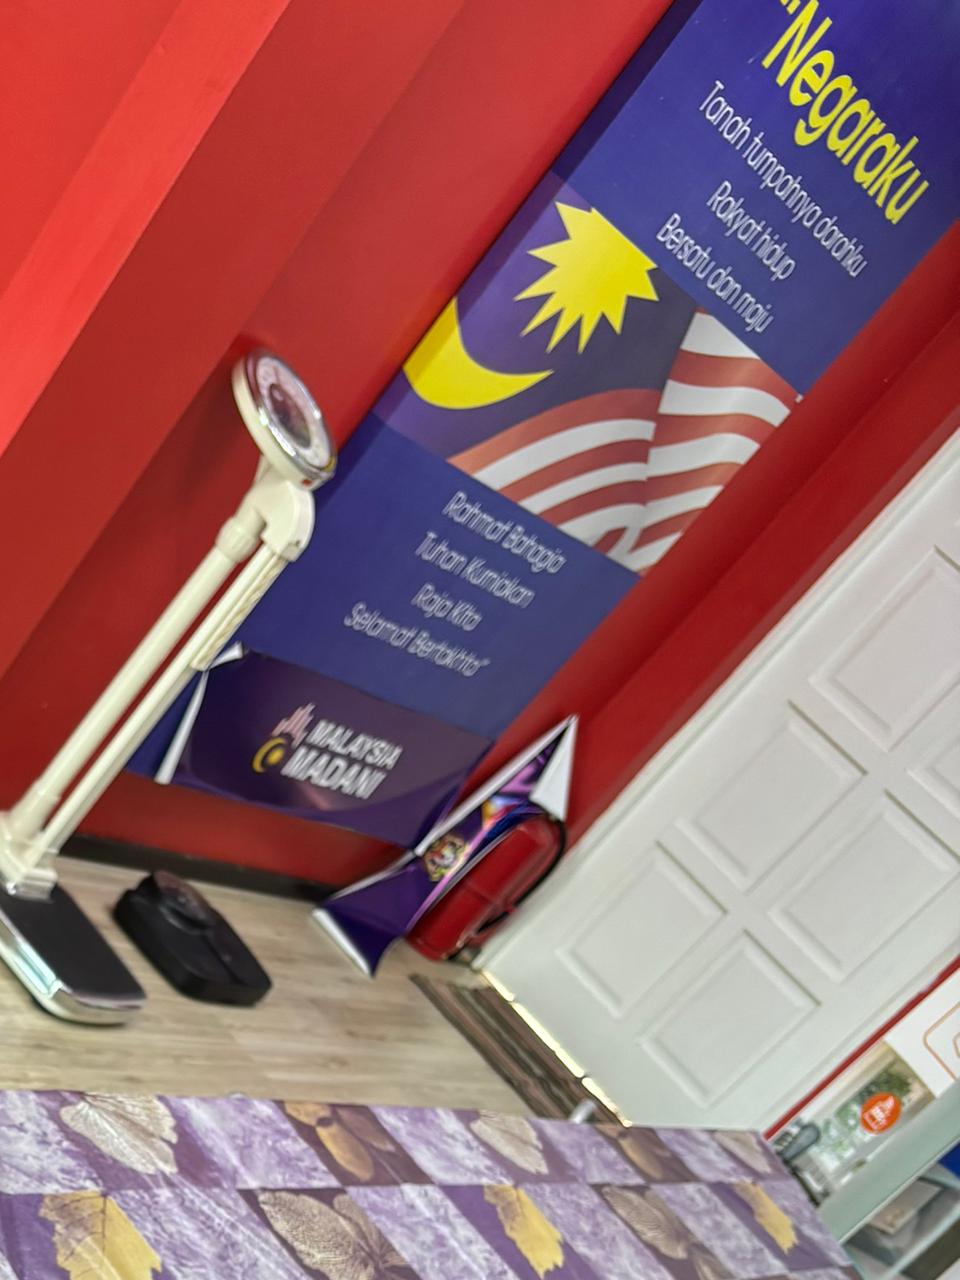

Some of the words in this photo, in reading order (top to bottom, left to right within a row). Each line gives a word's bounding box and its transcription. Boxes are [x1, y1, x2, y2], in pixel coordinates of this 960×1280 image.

[700, 81, 752, 150] Tanah
[742, 132, 822, 228] tumpahnya
[813, 216, 867, 277] darahku
[707, 181, 765, 245] Rakyat
[751, 228, 795, 281] hidup
[656, 213, 715, 279] Bersatu
[707, 267, 741, 304] dan
[733, 292, 773, 333] maju
[415, 532, 467, 574] Tuhan
[443, 491, 513, 542] Rahmat
[502, 525, 566, 573] Bahagia
[344, 603, 418, 650] Selamat
[411, 583, 454, 618] Raja
[447, 600, 481, 631] Kita
[306, 721, 402, 769] MALAYSIA
[282, 747, 386, 798] MADANI
